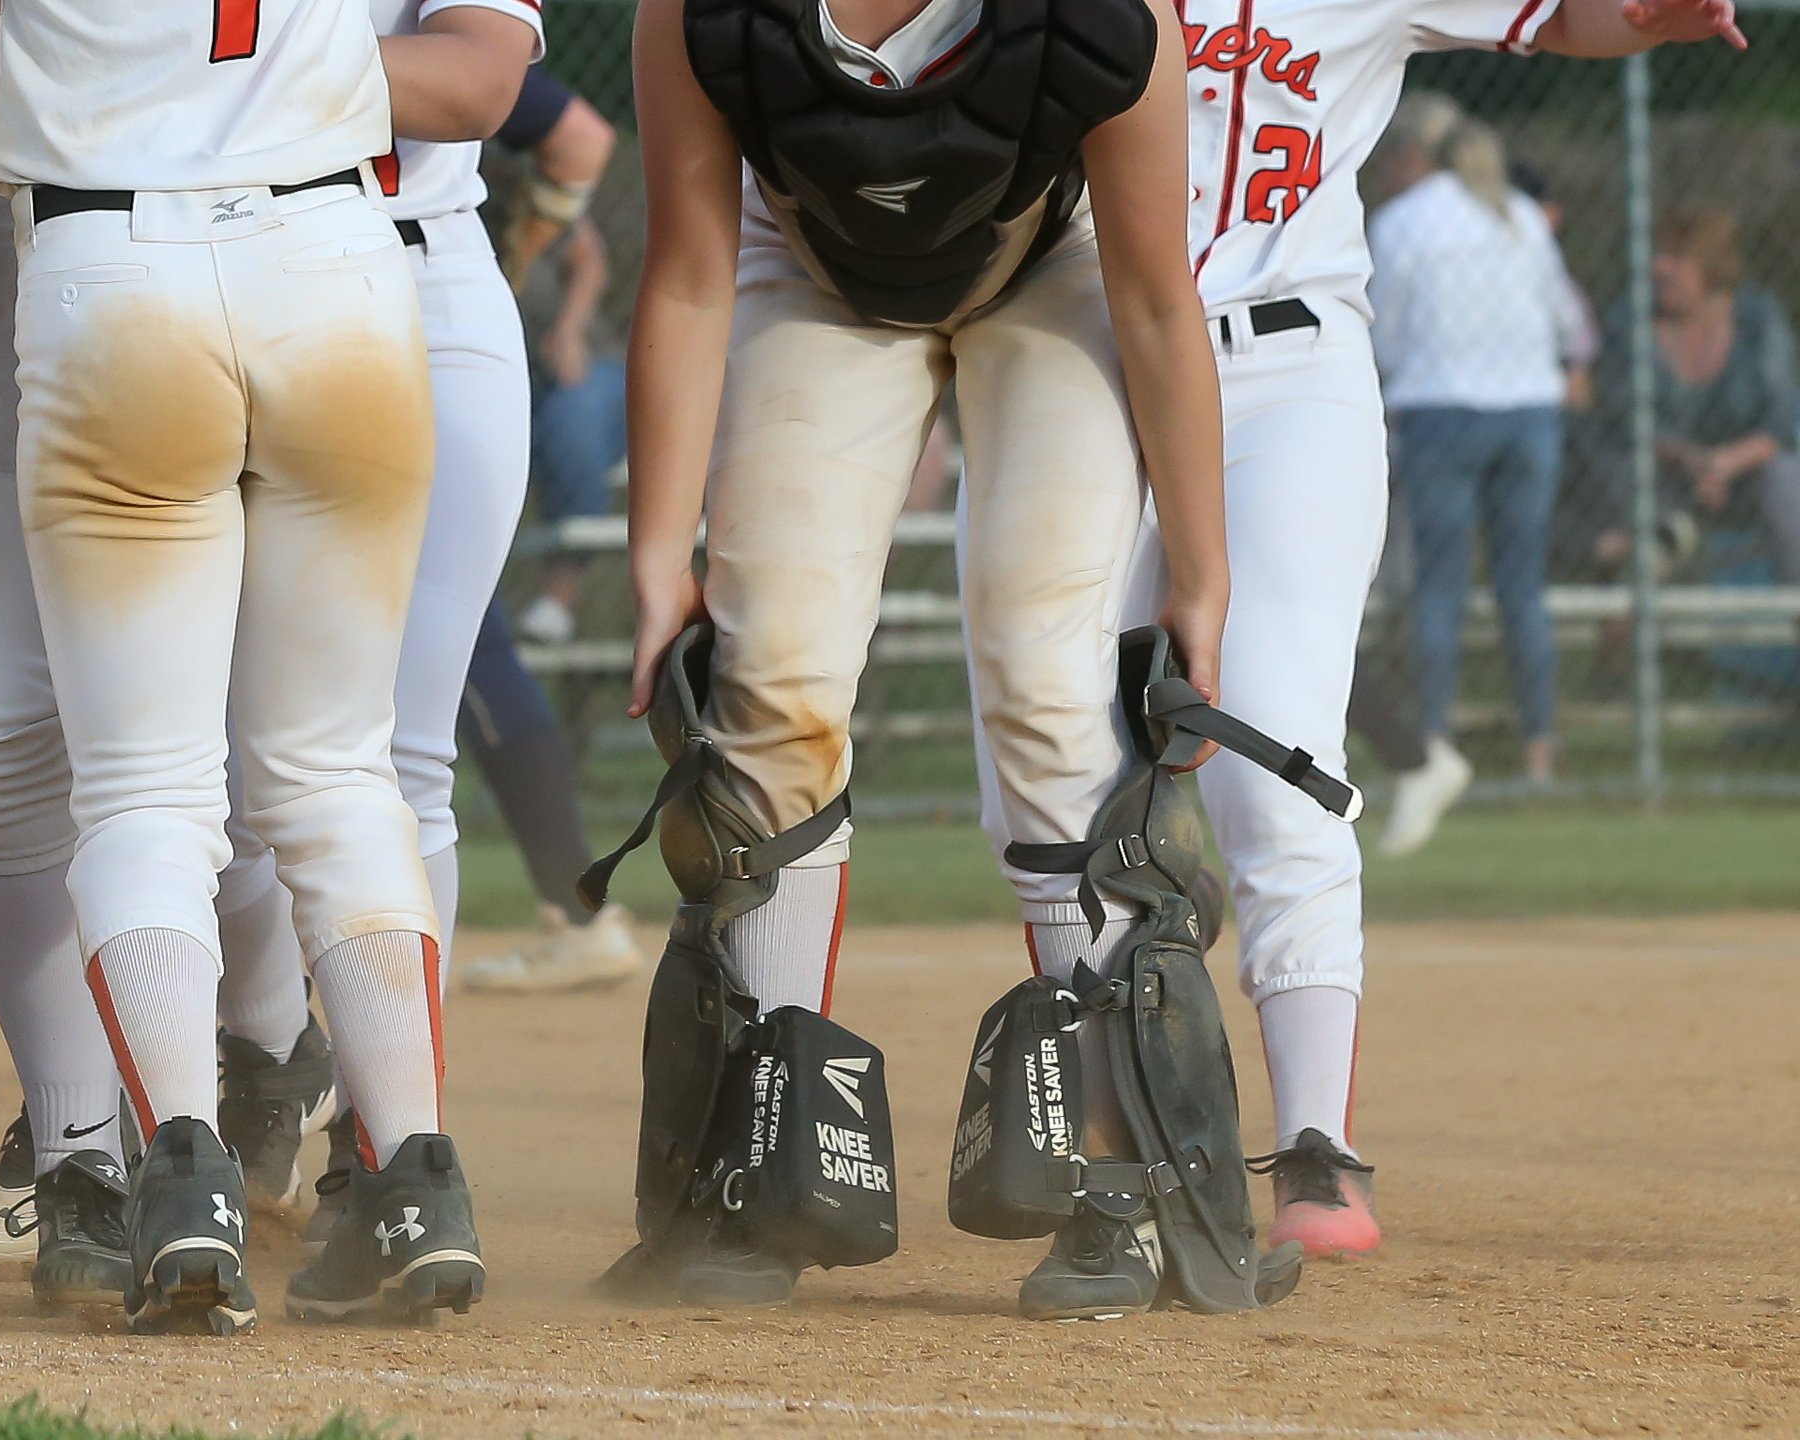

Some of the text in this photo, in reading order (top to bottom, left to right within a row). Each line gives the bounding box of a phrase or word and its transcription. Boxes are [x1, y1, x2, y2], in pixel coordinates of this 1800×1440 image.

[750, 1056, 774, 1168] KNEE SAVER
[767, 1078, 786, 1152] EASTON
[956, 1101, 991, 1153] KNEE
[1024, 1054, 1043, 1135] EASTON
[1040, 1037, 1068, 1157] KNEE SAVER
[815, 1121, 873, 1161] KNEE
[820, 1152, 892, 1193] SAVER
[953, 1125, 993, 1181] SAVER
